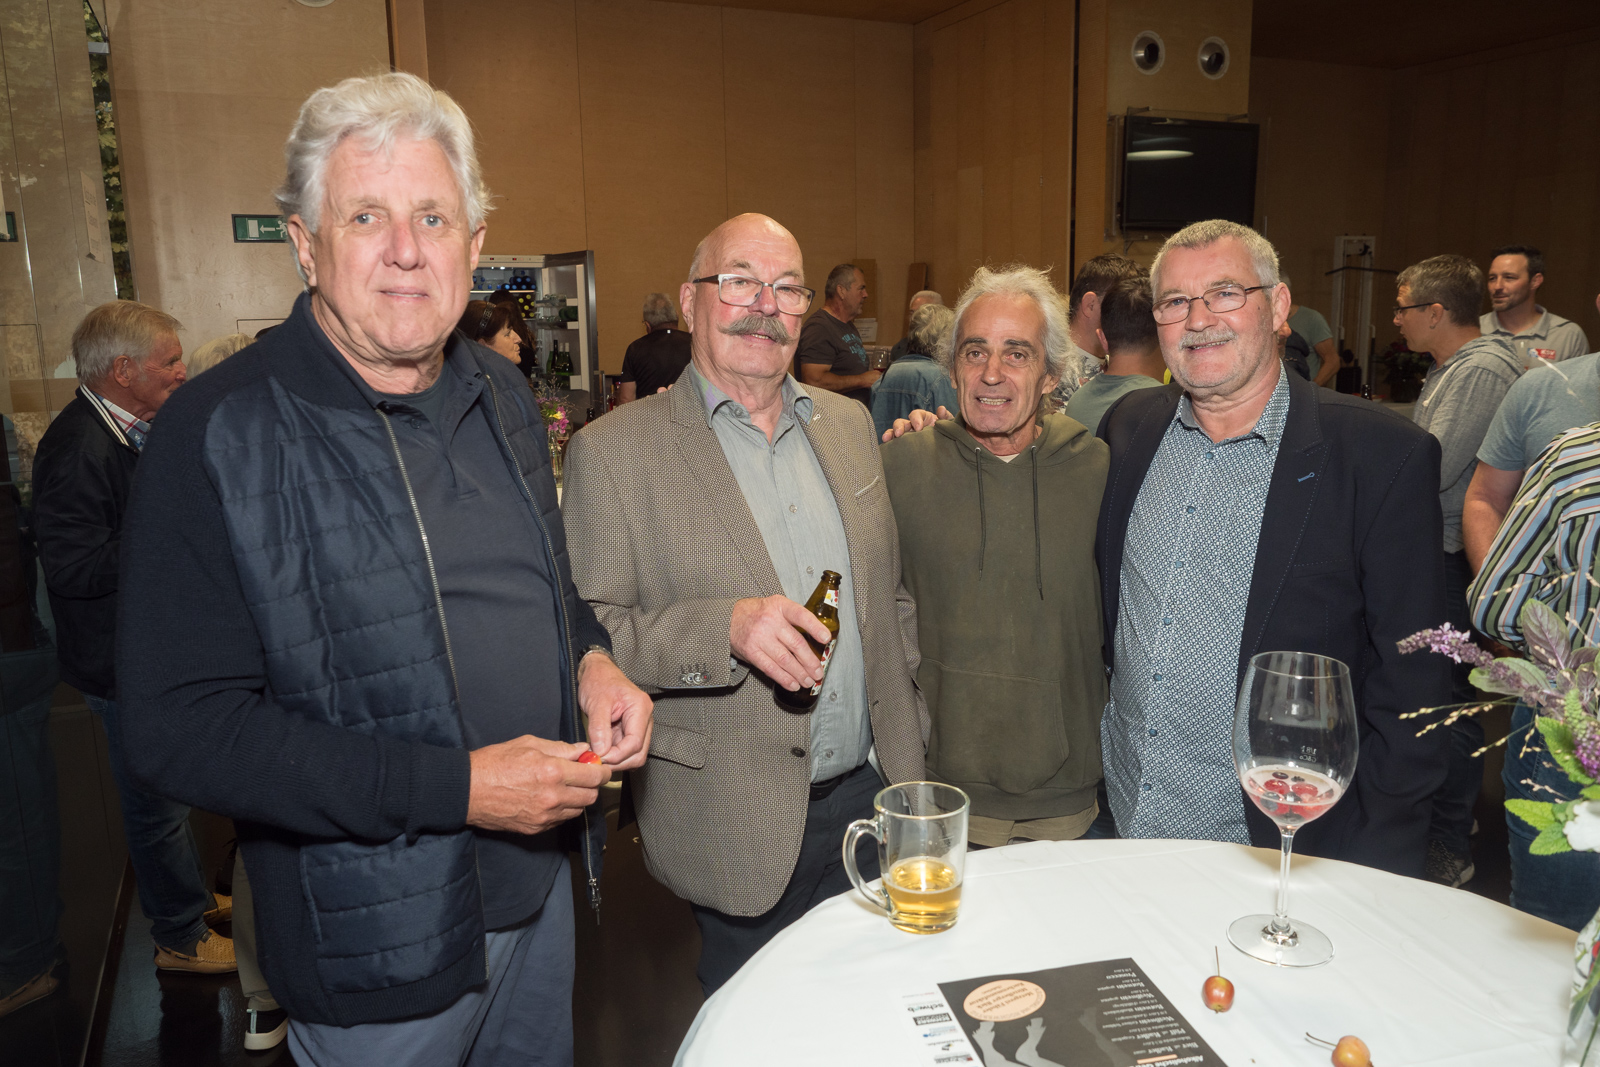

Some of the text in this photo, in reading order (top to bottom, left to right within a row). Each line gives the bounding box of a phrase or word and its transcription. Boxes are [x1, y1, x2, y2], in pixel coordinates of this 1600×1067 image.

[1120, 993, 1154, 1001] Weißwein
[1134, 1004, 1164, 1012] Rotwein
[1138, 1016, 1174, 1024] Weißwein
[1136, 1032, 1161, 1040] Radler
[1148, 1045, 1173, 1054] Radler
[1155, 1055, 1203, 1066] Alkoholische
